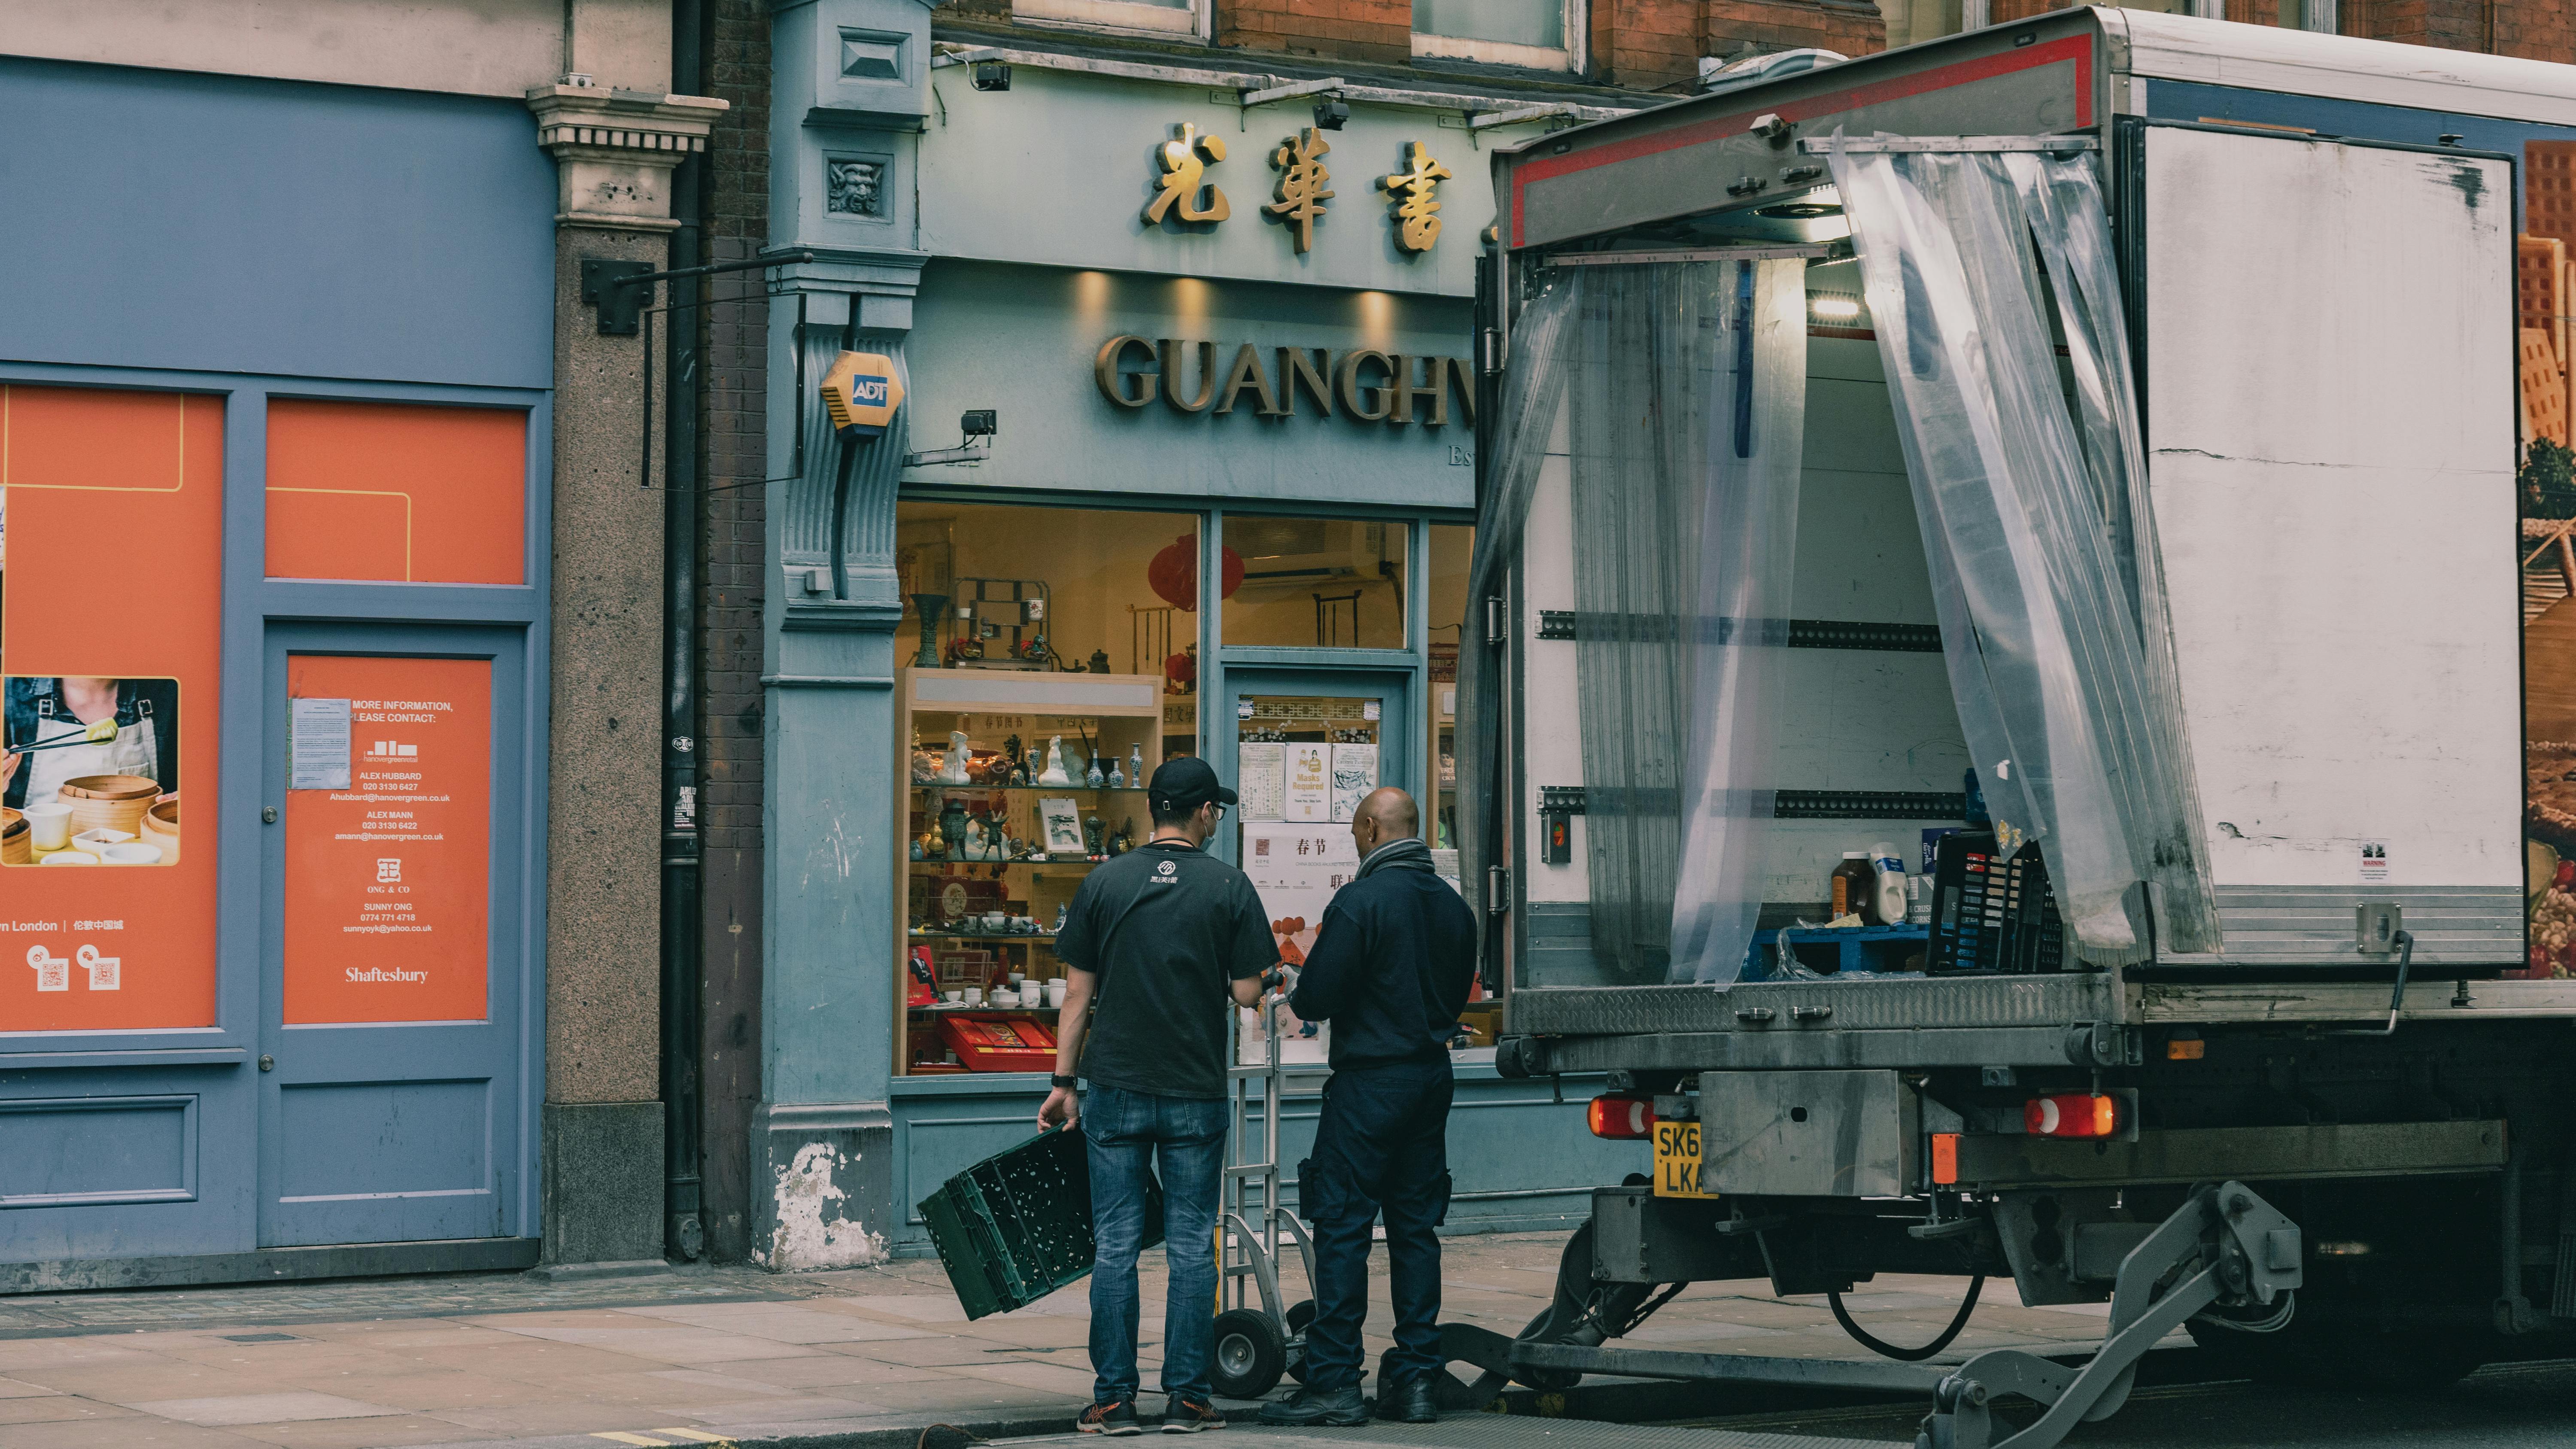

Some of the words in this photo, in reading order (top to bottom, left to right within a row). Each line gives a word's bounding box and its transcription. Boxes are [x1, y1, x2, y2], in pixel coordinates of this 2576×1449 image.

[1140, 122, 1498, 255] 光華書
[853, 381, 887, 400] ADT
[1449, 445, 1476, 466] Es
[352, 700, 382, 709] MORE
[383, 701, 453, 712] INFORMATION,
[387, 713, 436, 723] CONTACT:
[1293, 782, 1324, 791] Required
[330, 793, 450, 802] Ahubbard@hanovergreen.co.uk
[334, 832, 444, 842] amann@hanovergreen.co.uk
[1296, 838, 1326, 855] 春节
[12, 920, 58, 932] London
[73, 920, 124, 930] 伦敦中国城
[343, 924, 432, 934] sunnyoyk@yahoo.co.uk
[346, 967, 428, 984] Shaftesbury
[1659, 1127, 1699, 1157] SK6
[1666, 1162, 1704, 1193] LKA
